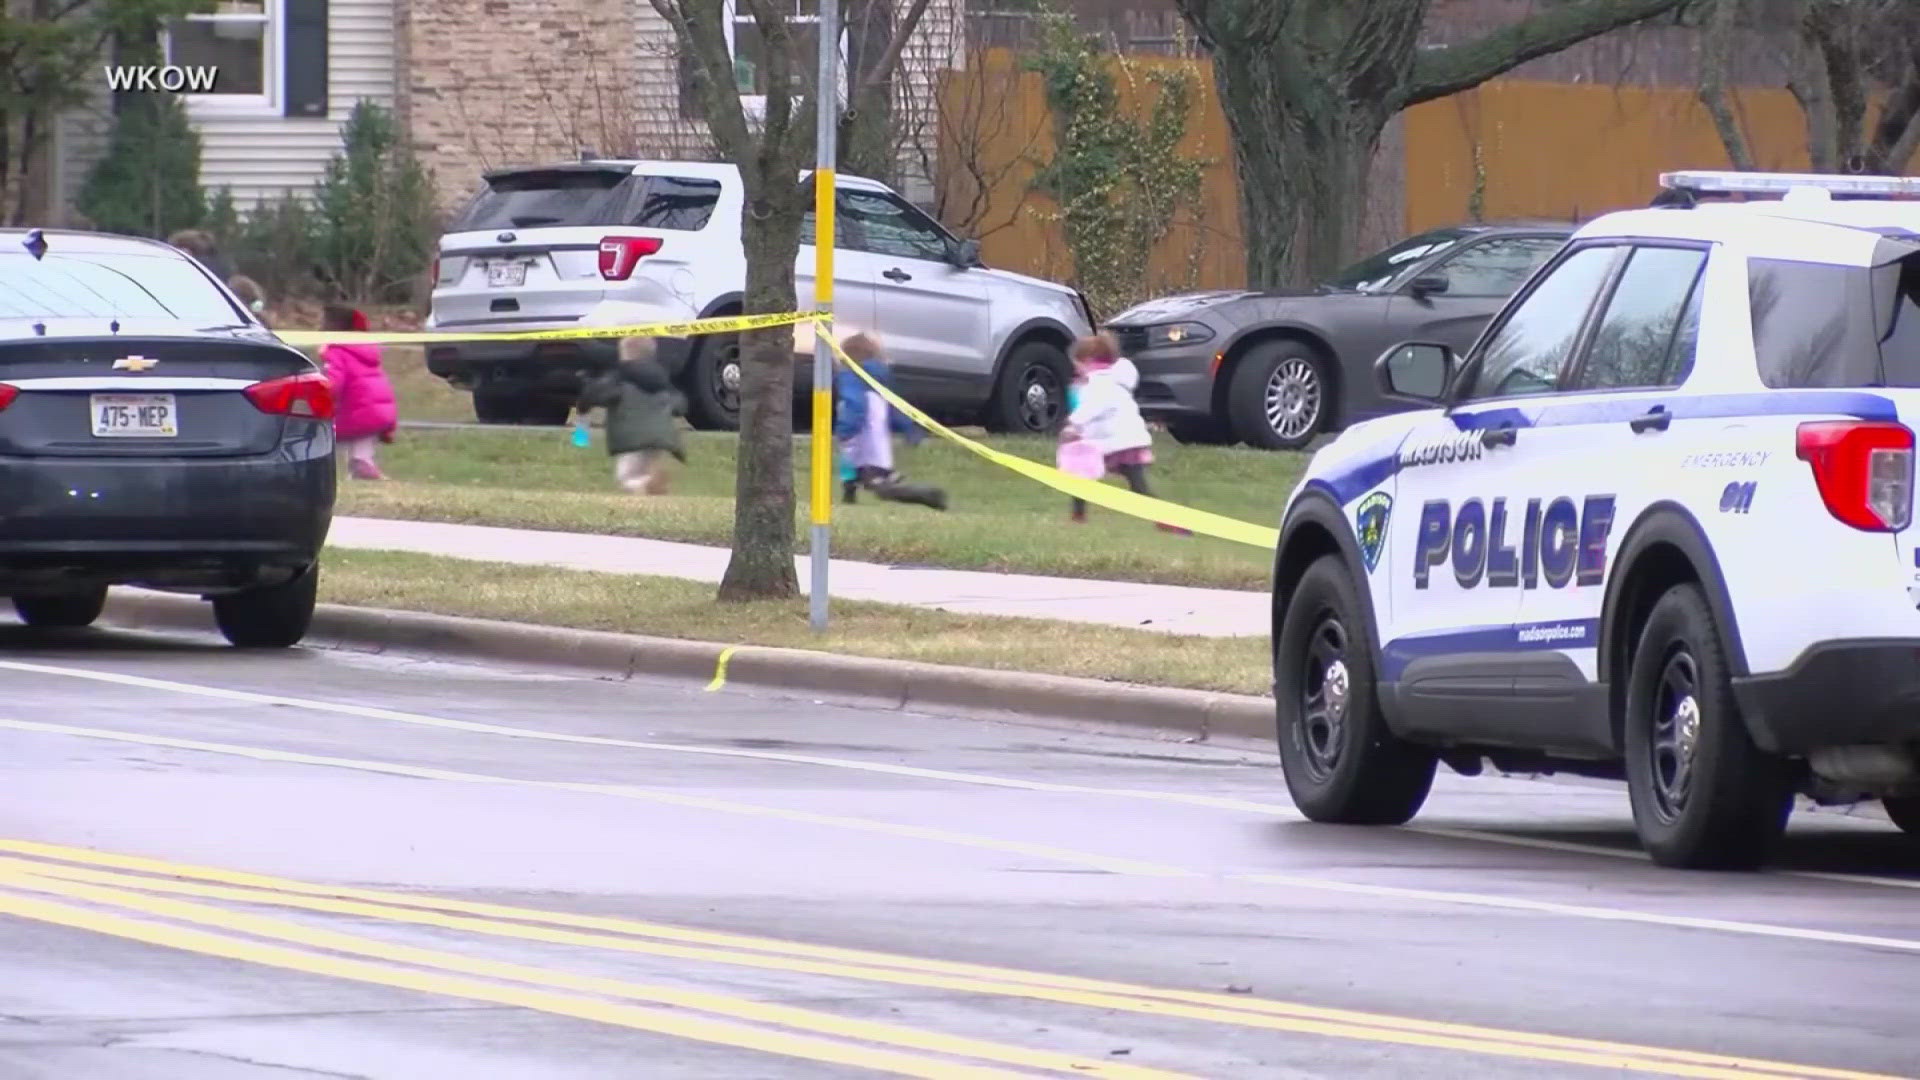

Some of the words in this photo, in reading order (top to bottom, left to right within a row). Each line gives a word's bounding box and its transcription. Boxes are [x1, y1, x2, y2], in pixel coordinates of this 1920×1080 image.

[1400, 428, 1486, 468] MADISON
[1680, 450, 1773, 468] EMERGENCY
[1413, 494, 1617, 590] POLICE
